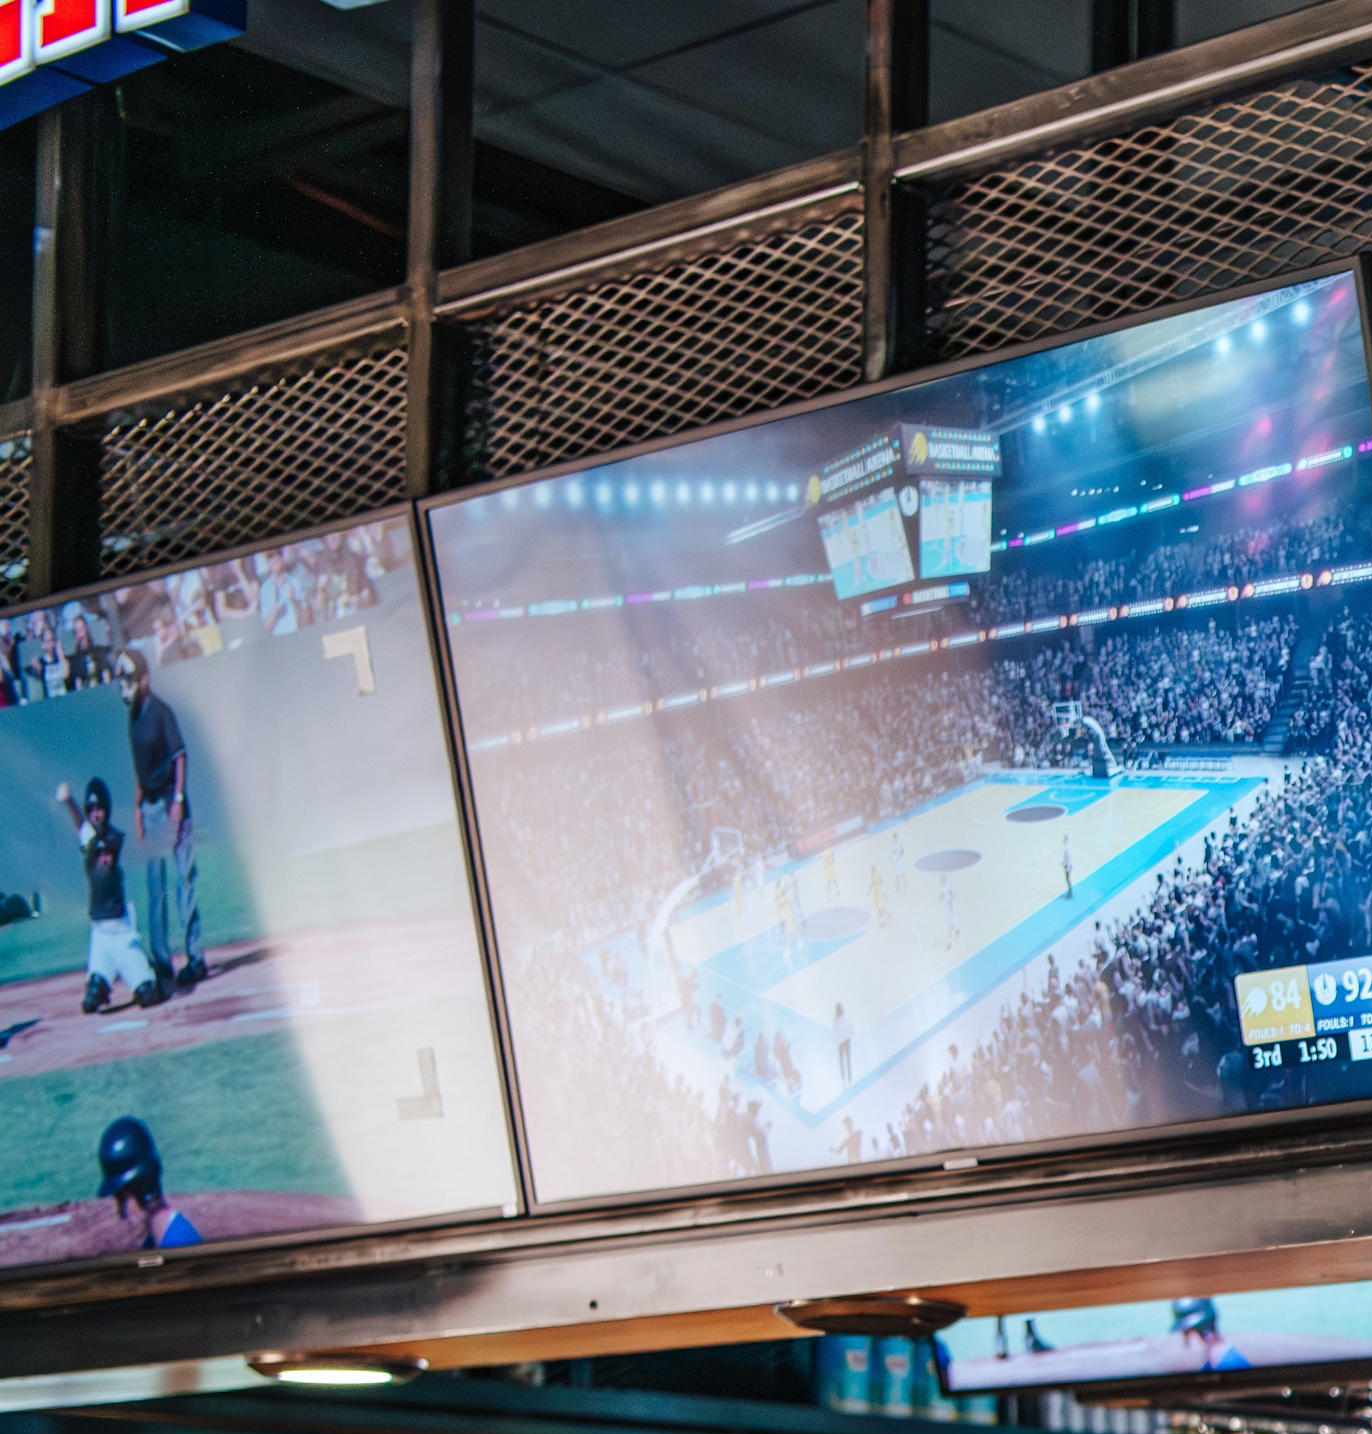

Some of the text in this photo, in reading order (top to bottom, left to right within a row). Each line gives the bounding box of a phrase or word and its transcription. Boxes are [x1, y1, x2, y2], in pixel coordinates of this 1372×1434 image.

[928, 442, 971, 460] BASKETBALL
[821, 446, 896, 495] BASKETBALL ARENA
[1269, 978, 1302, 1013] 84
[1252, 1043, 1282, 1069] 3rd
[1298, 1037, 1338, 1063] 1:50
